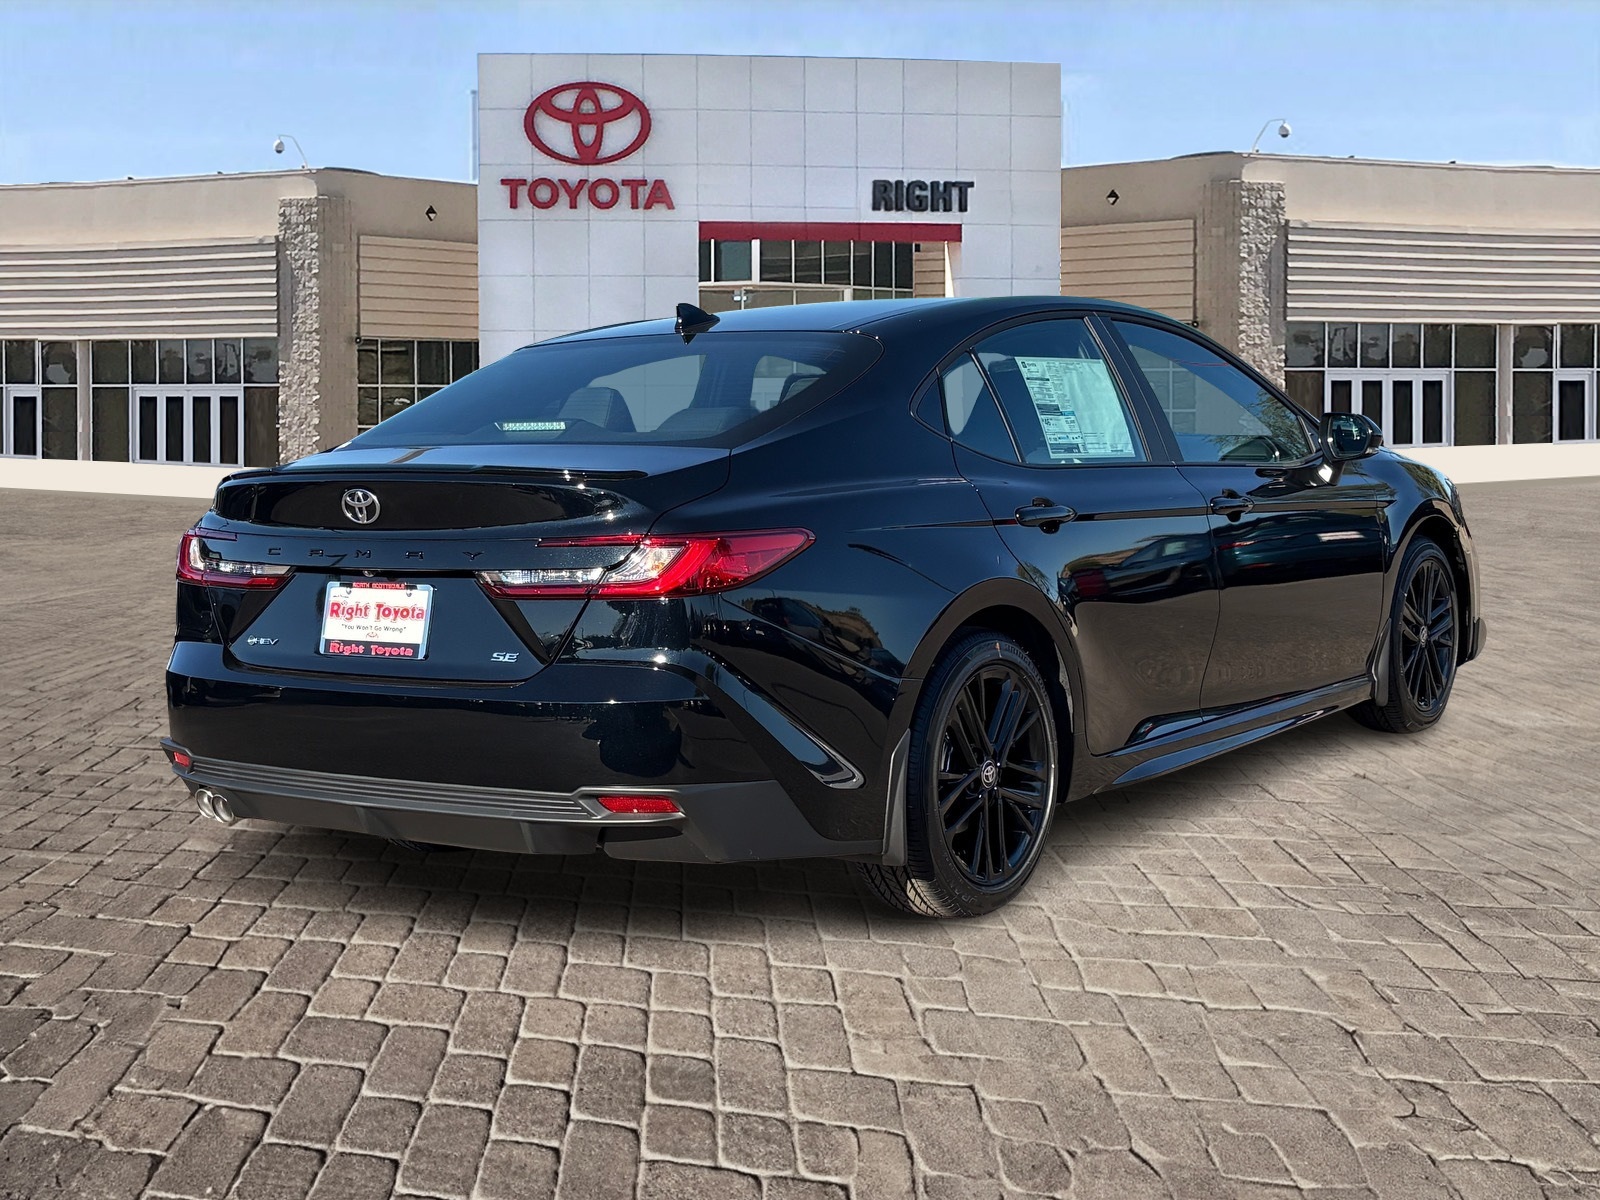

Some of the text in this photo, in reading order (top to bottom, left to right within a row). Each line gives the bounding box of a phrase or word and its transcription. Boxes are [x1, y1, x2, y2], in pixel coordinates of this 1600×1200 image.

[500, 177, 675, 210] TOYOTA
[872, 179, 975, 213] RIGHT
[267, 547, 484, 561] CAMRY
[329, 602, 425, 621] Right Toyota
[329, 641, 413, 657] Right Toyota
[490, 652, 520, 662] SE
